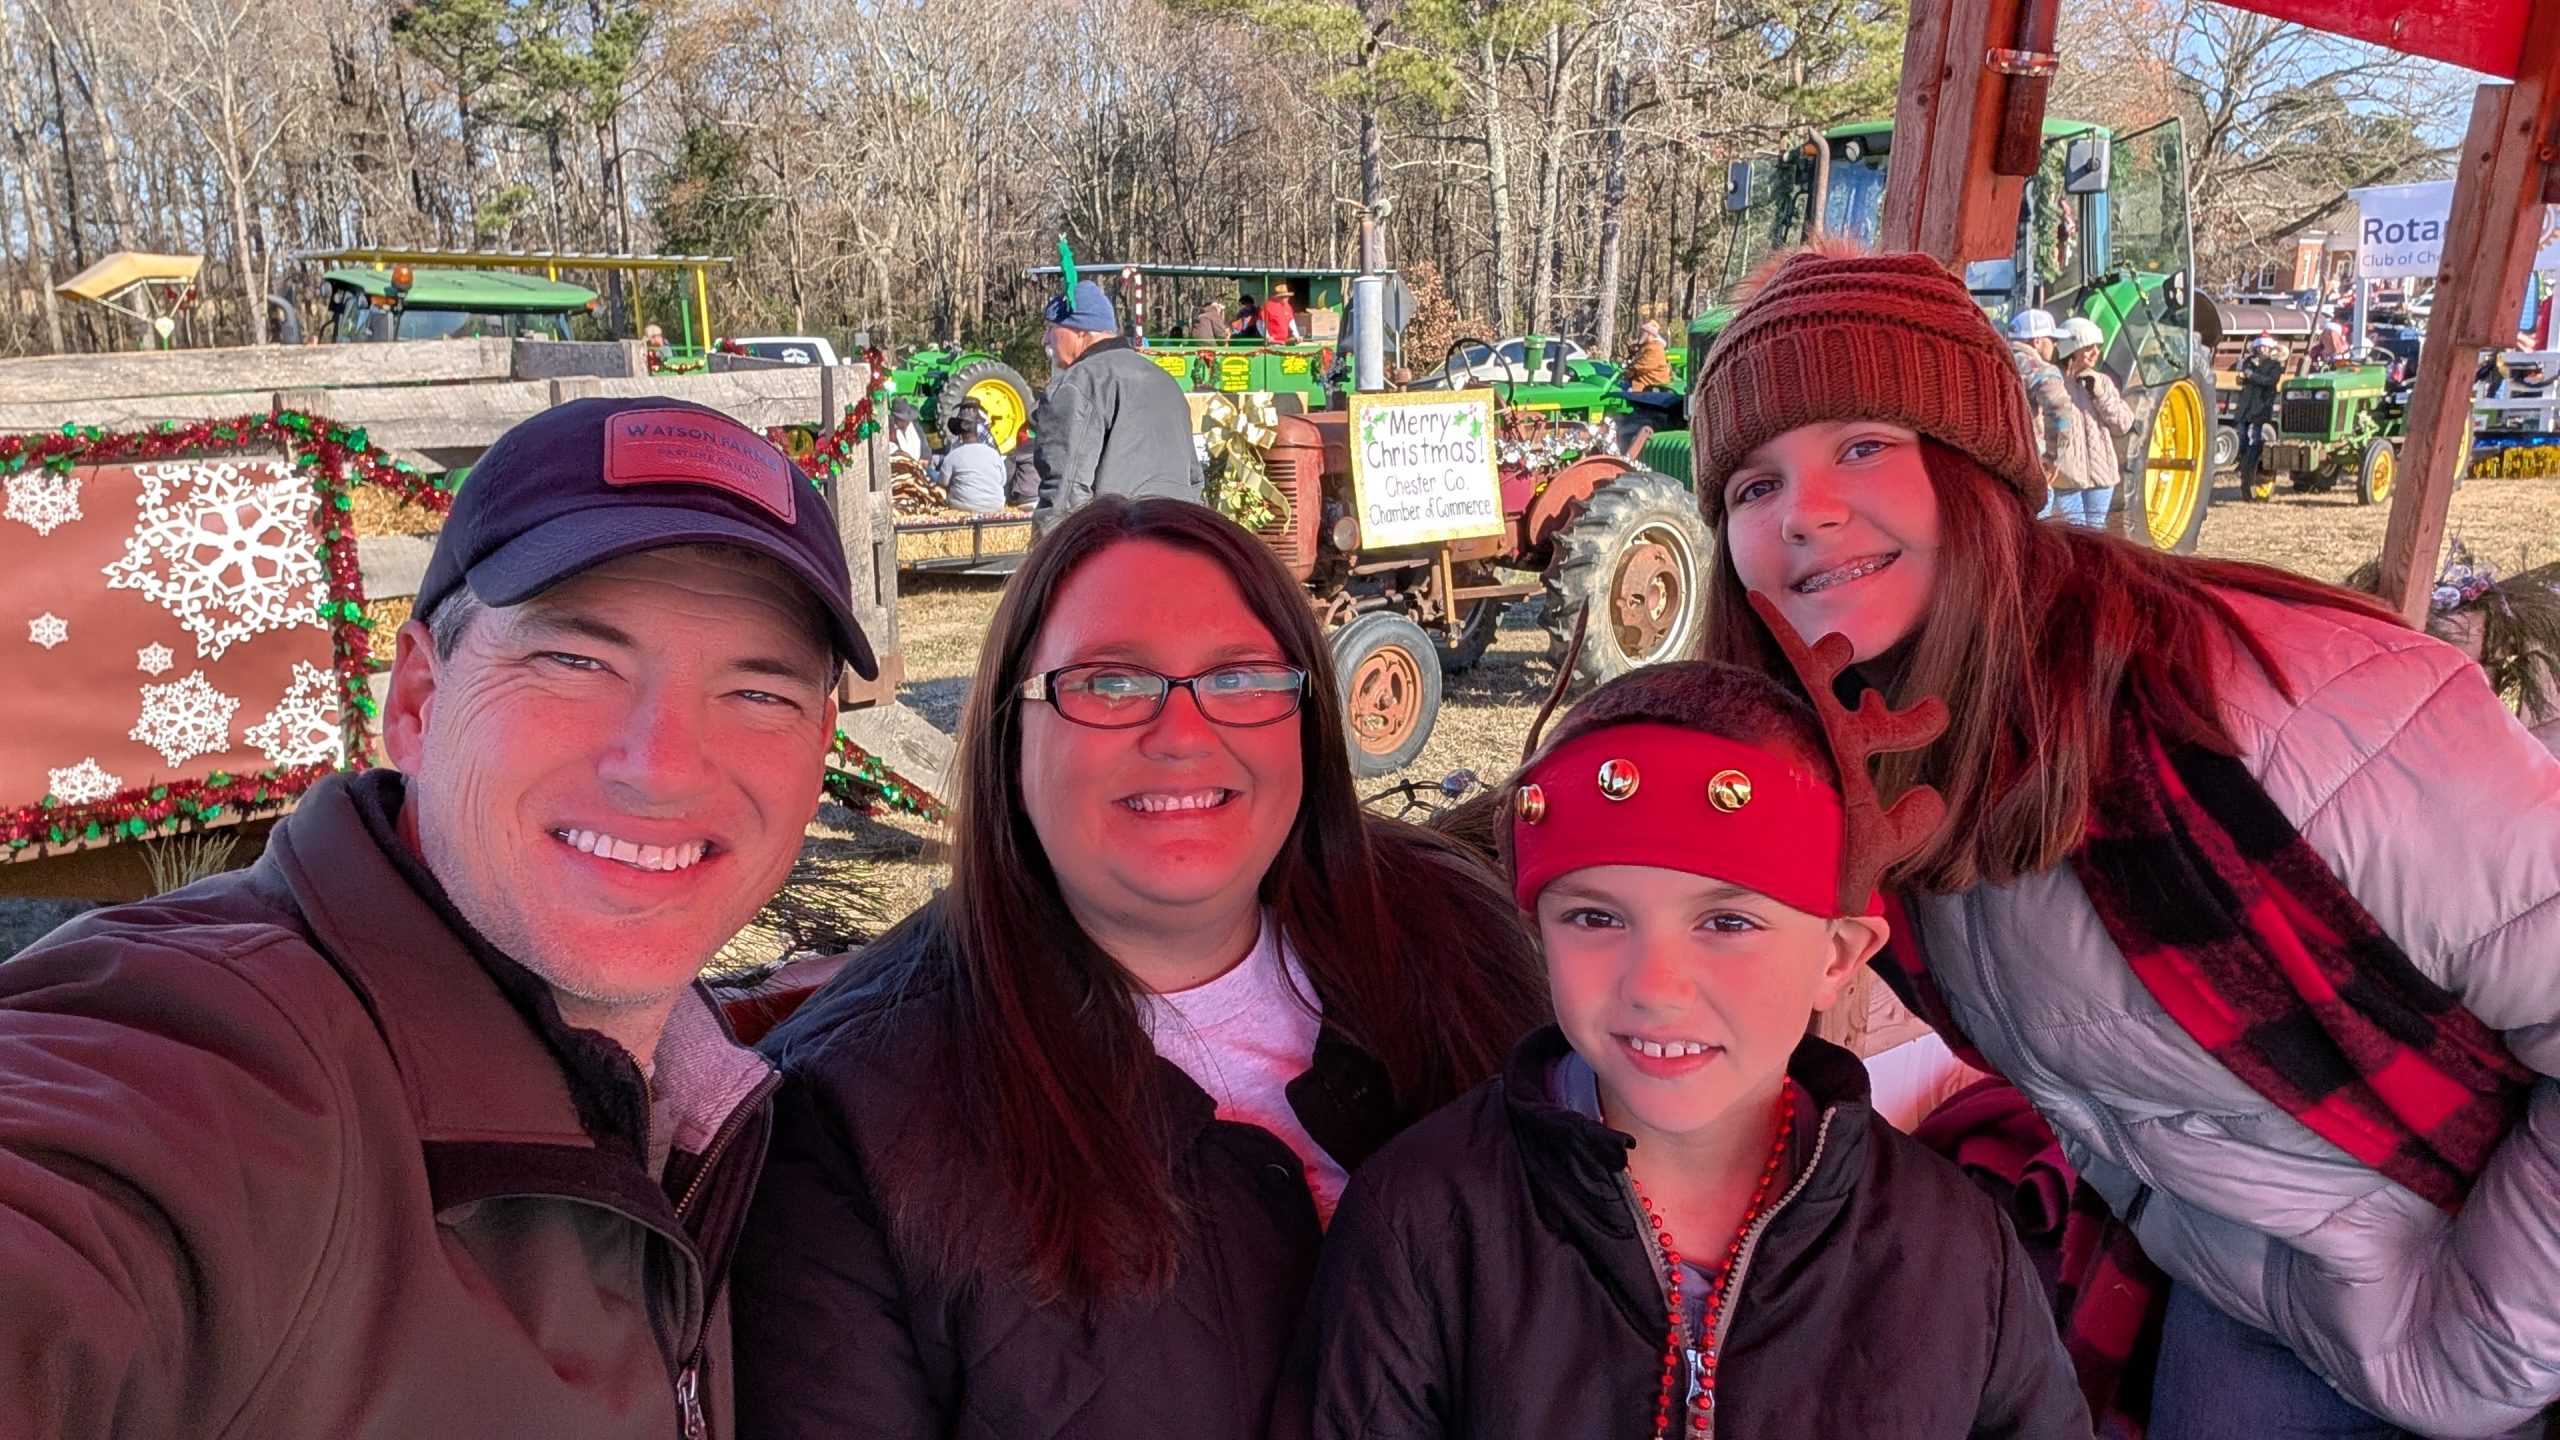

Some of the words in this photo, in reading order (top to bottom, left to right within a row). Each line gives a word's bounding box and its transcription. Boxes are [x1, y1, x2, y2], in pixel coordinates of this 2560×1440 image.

[2363, 217, 2449, 245] Rota
[2362, 252, 2394, 267] Club
[2397, 251, 2413, 265] of
[627, 424, 717, 443] WATSON
[1389, 409, 1451, 443] Merry
[1367, 436, 1485, 469] Christmas!
[1385, 472, 1437, 498] Chester
[1444, 469, 1470, 492] Co.
[1369, 501, 1421, 526] Chamber
[1425, 497, 1435, 519] of
[1435, 496, 1492, 519] Commerce
